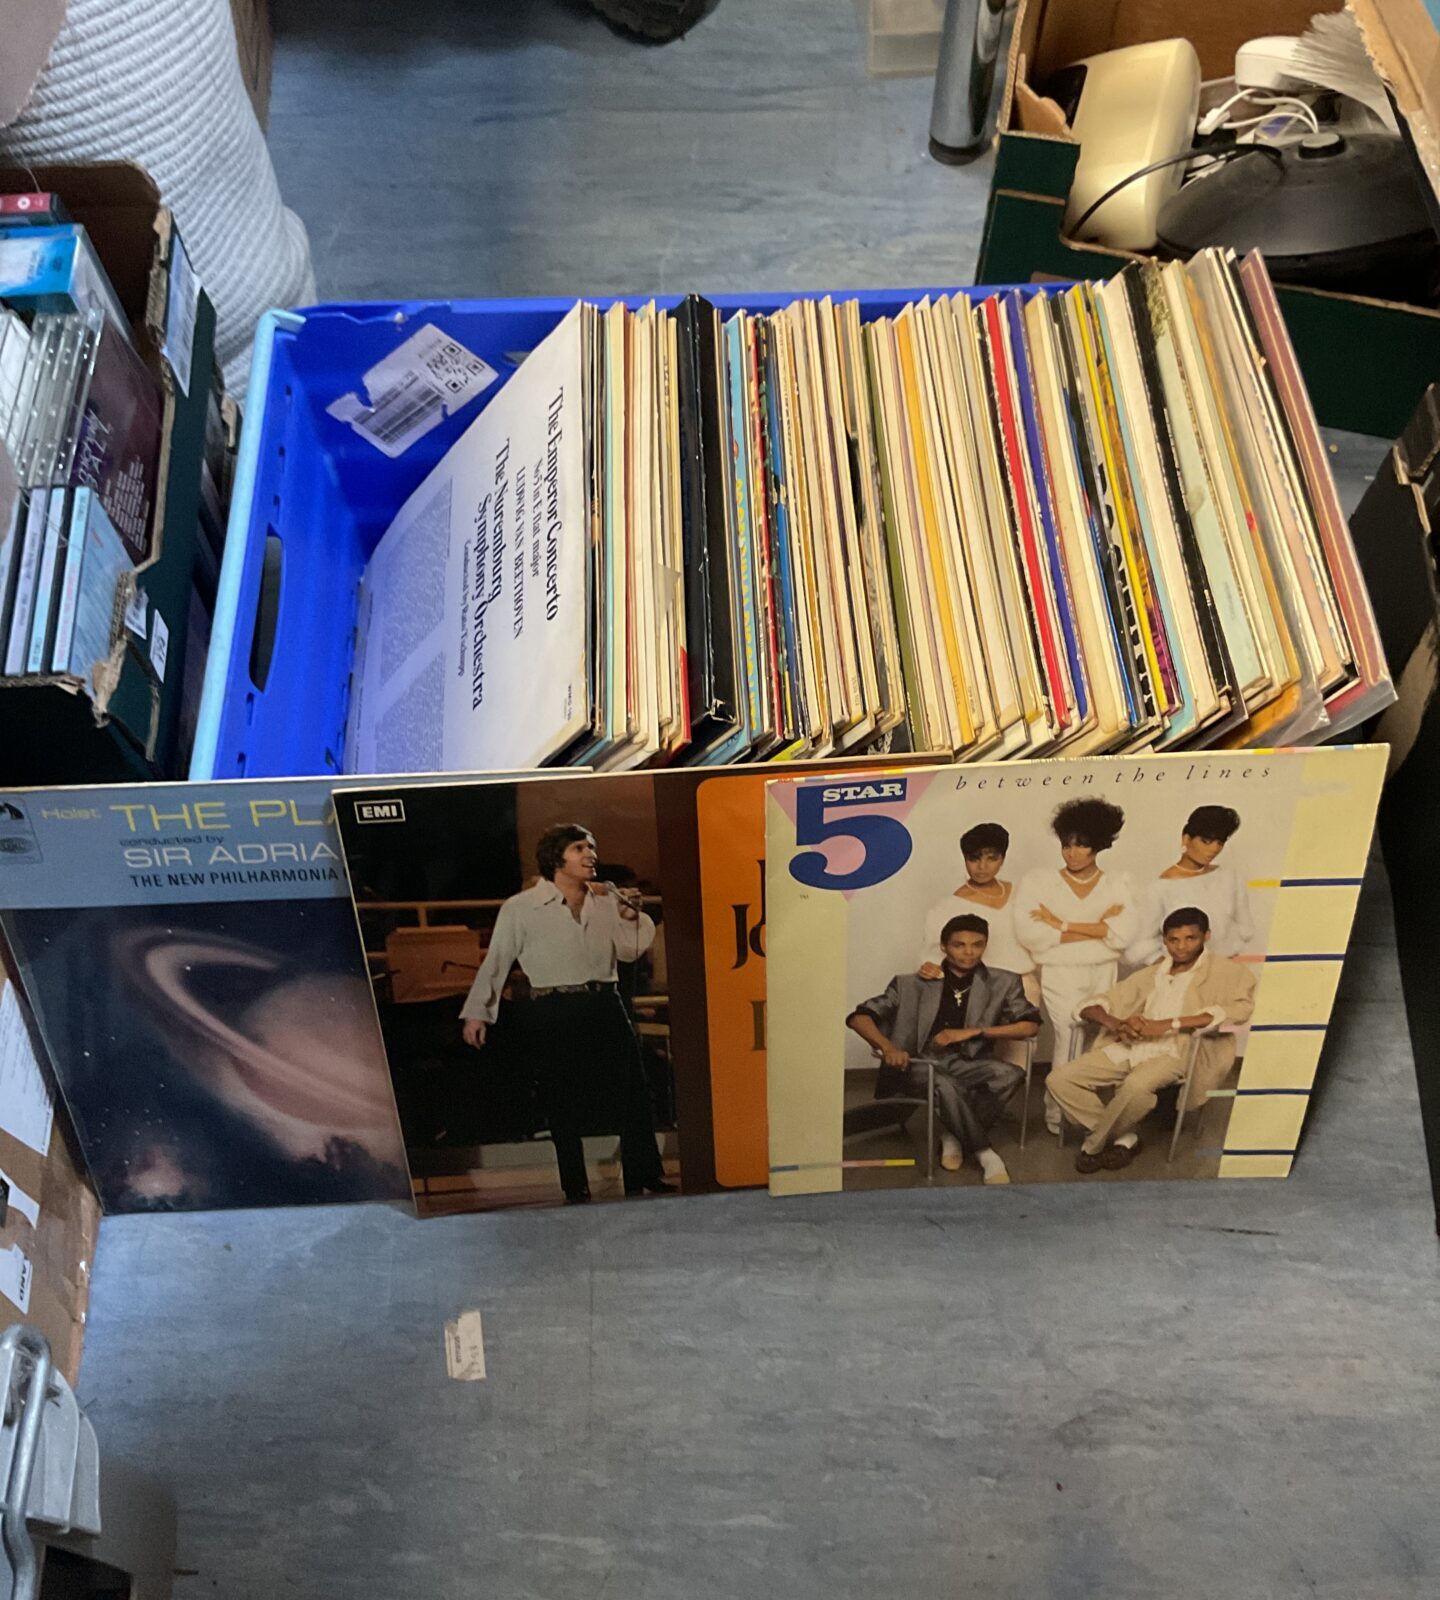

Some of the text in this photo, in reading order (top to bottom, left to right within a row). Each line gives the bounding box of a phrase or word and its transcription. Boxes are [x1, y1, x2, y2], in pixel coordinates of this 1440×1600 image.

[544, 386, 563, 621] The Emperor Concerto
[488, 437, 510, 603] The Nuremburg
[533, 511, 542, 538] flat
[513, 466, 526, 640] LUDWIG VAN BEETHOVEN
[530, 540, 541, 577] major
[472, 493, 492, 711] Symphony Orchestra
[955, 764, 1273, 791] between the lines
[823, 783, 904, 803] STAR
[109, 801, 231, 832] THE
[362, 805, 397, 818] EMI
[119, 834, 224, 847] conducted by
[788, 778, 913, 891] 5
[124, 846, 193, 869] SIR
[129, 874, 163, 888] THE
[168, 872, 205, 886] NEW
[210, 868, 340, 885] PHILHARMONIA
